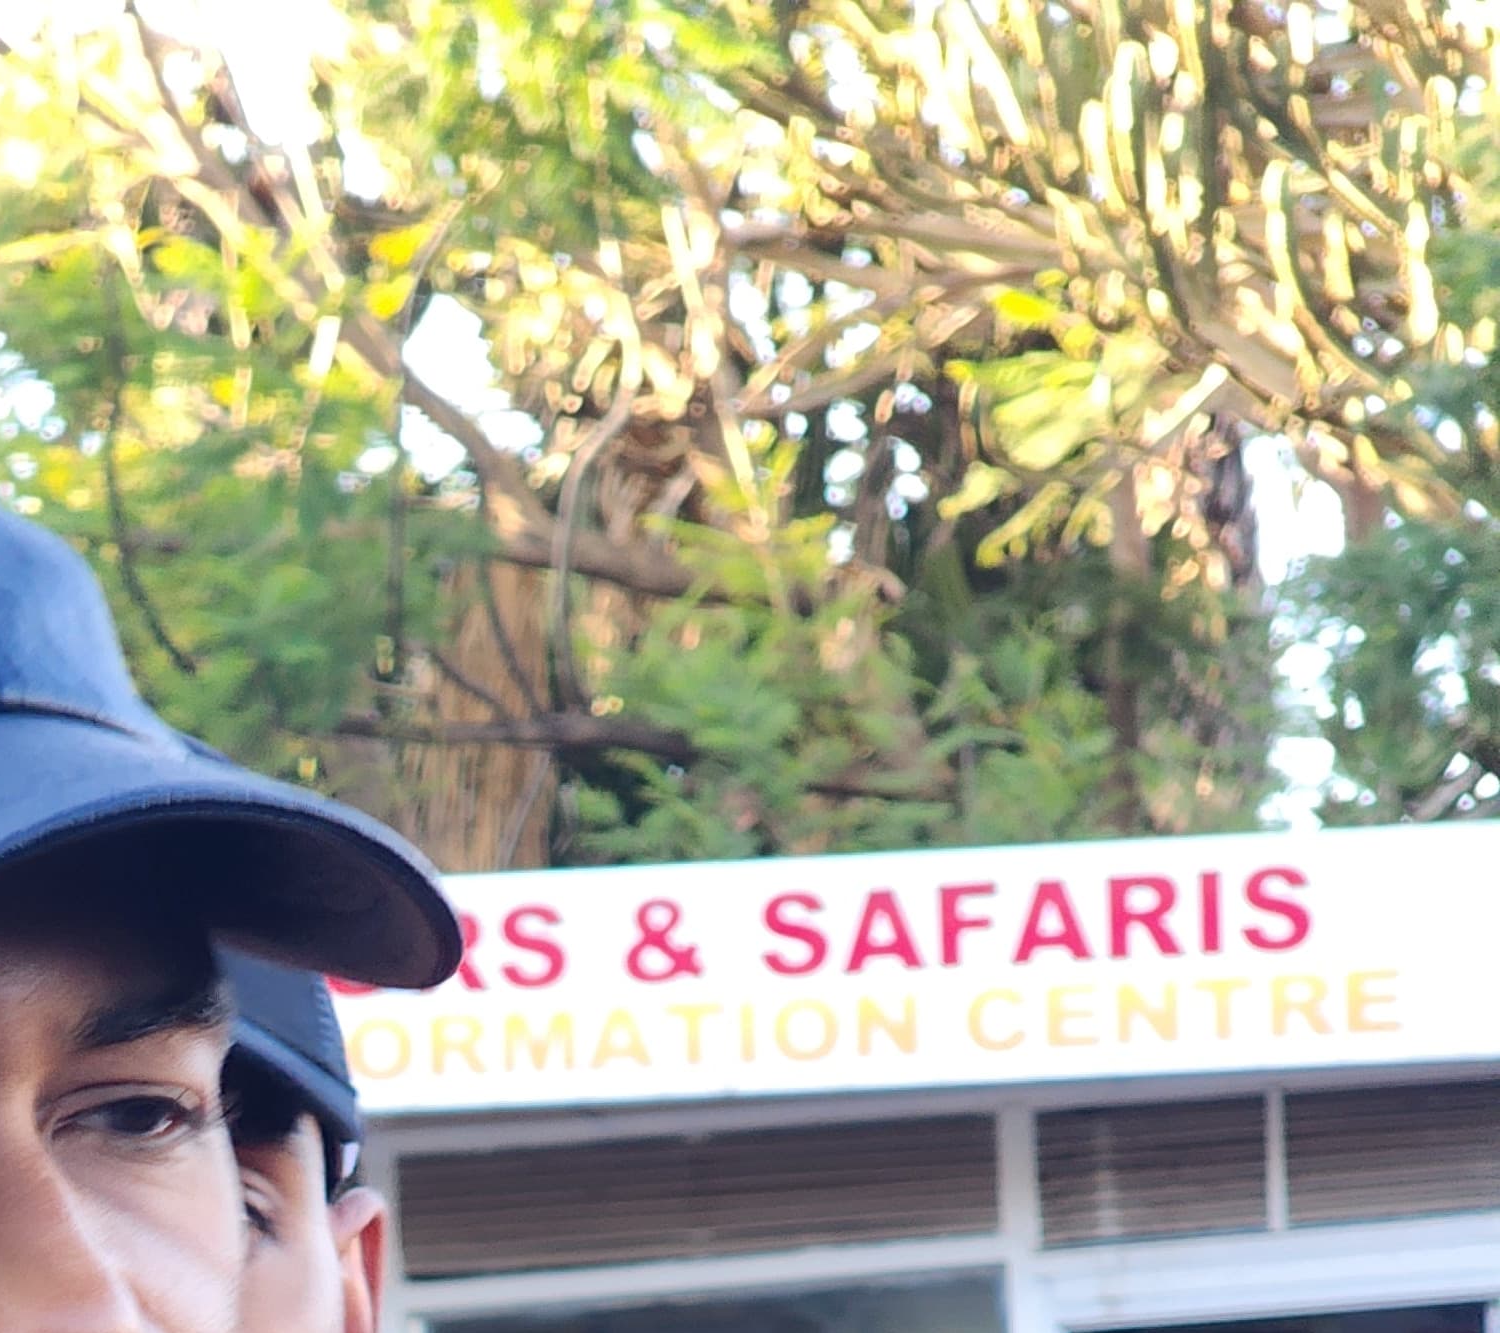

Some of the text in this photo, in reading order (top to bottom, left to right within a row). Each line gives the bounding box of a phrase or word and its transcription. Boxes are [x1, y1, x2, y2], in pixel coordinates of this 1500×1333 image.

[624, 898, 703, 982] &
[761, 866, 1312, 978] SAFARIS
[348, 969, 1402, 1079] ORMATION CENTRE
